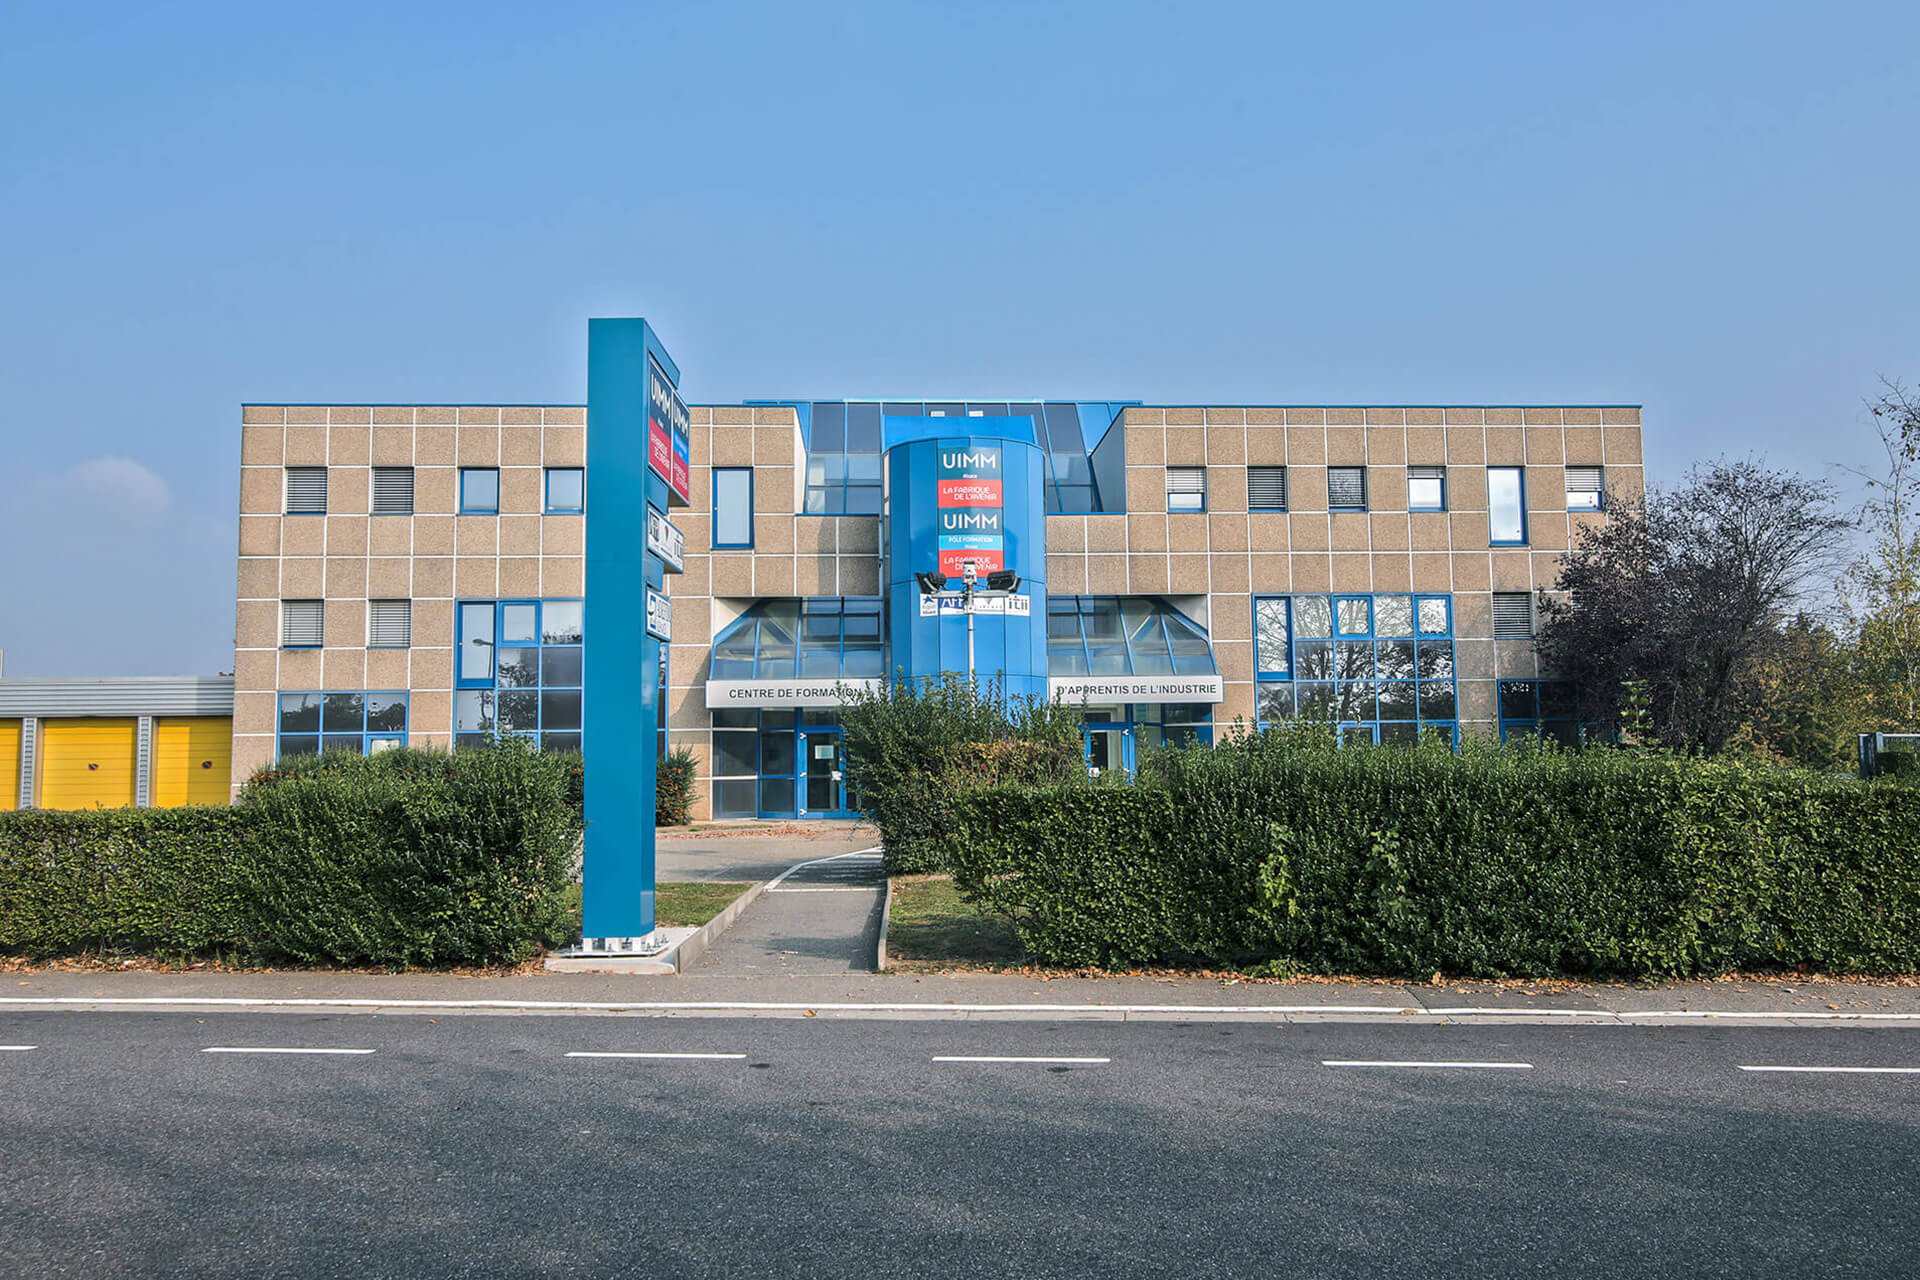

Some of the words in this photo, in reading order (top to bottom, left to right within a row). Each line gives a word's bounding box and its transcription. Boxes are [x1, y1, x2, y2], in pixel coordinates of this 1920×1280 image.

[651, 373, 671, 419] UIMM
[943, 453, 996, 469] UIMM
[954, 486, 990, 495] FABRIQUE
[944, 513, 998, 529] UIMM
[728, 688, 774, 698] CENTRE
[778, 688, 793, 698] DE
[796, 687, 862, 698] FORMAION
[1132, 684, 1147, 694] DE
[1150, 683, 1217, 694] L'INDUSTRIE
